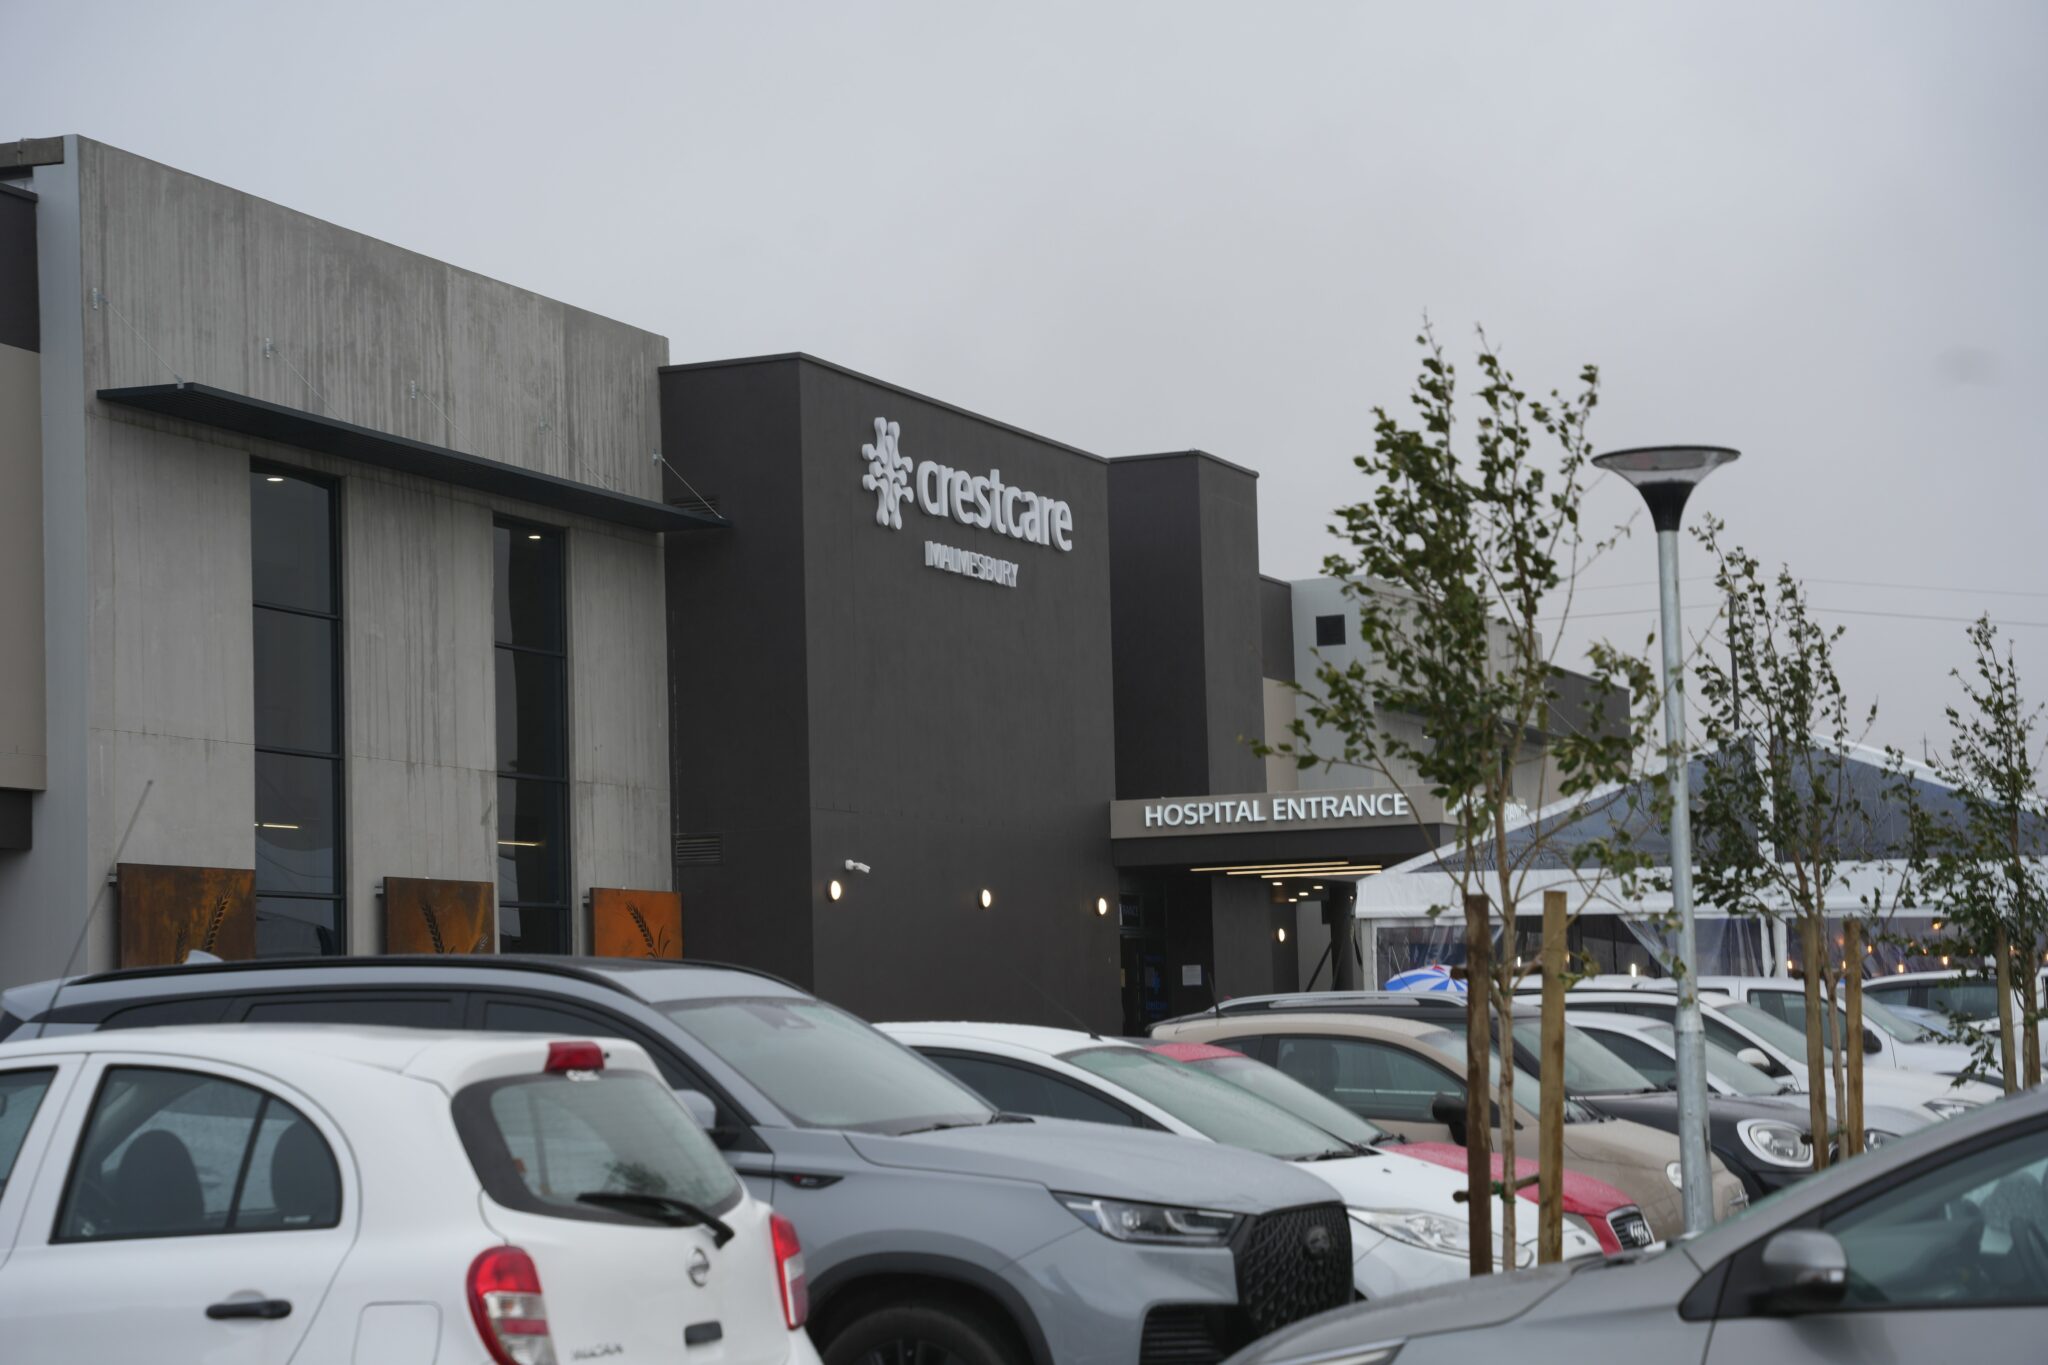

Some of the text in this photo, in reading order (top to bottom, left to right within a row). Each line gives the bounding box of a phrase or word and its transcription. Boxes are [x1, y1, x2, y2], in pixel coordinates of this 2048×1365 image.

[916, 460, 1073, 551] crestcare
[925, 541, 1019, 587] MALMESBURY
[1145, 793, 1409, 827] HOSPITAL ENTRANCE
